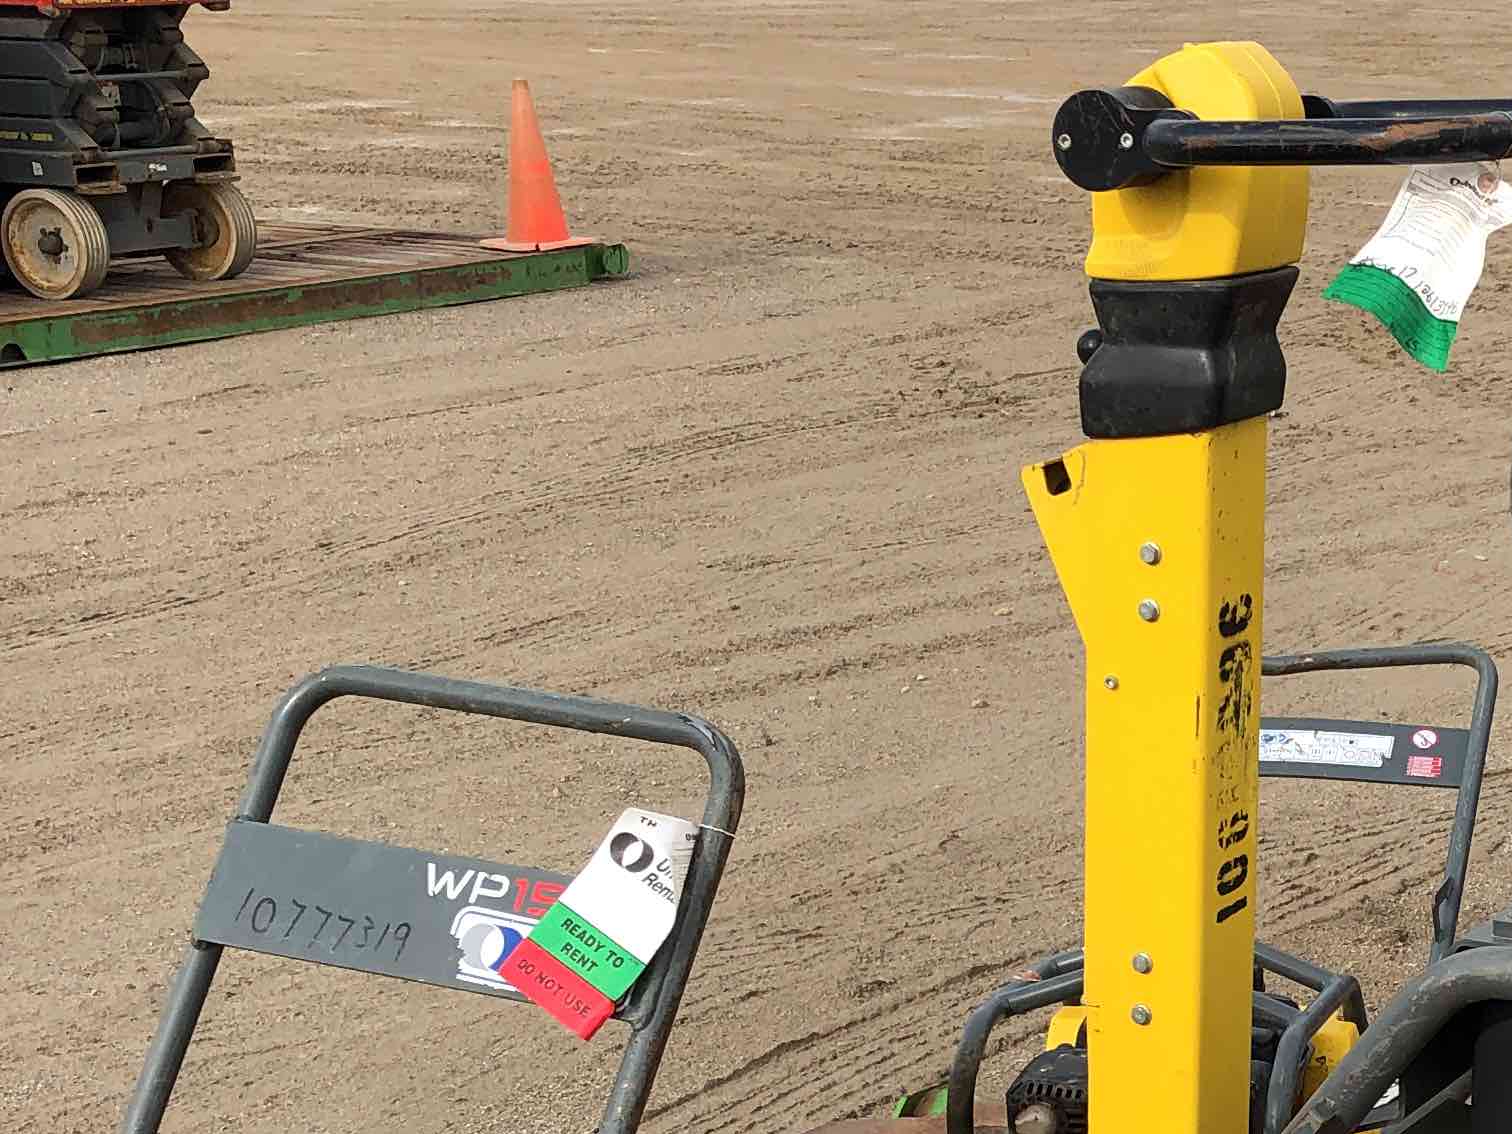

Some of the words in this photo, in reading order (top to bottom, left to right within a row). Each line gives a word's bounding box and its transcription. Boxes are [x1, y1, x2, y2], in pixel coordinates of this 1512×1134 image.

[235, 887, 412, 961] 10777319
[561, 918, 606, 953] READY
[605, 949, 625, 969] TO
[561, 942, 599, 973] RENT
[517, 959, 535, 976] DO
[536, 967, 564, 995] NOT
[564, 990, 591, 1018] USE
